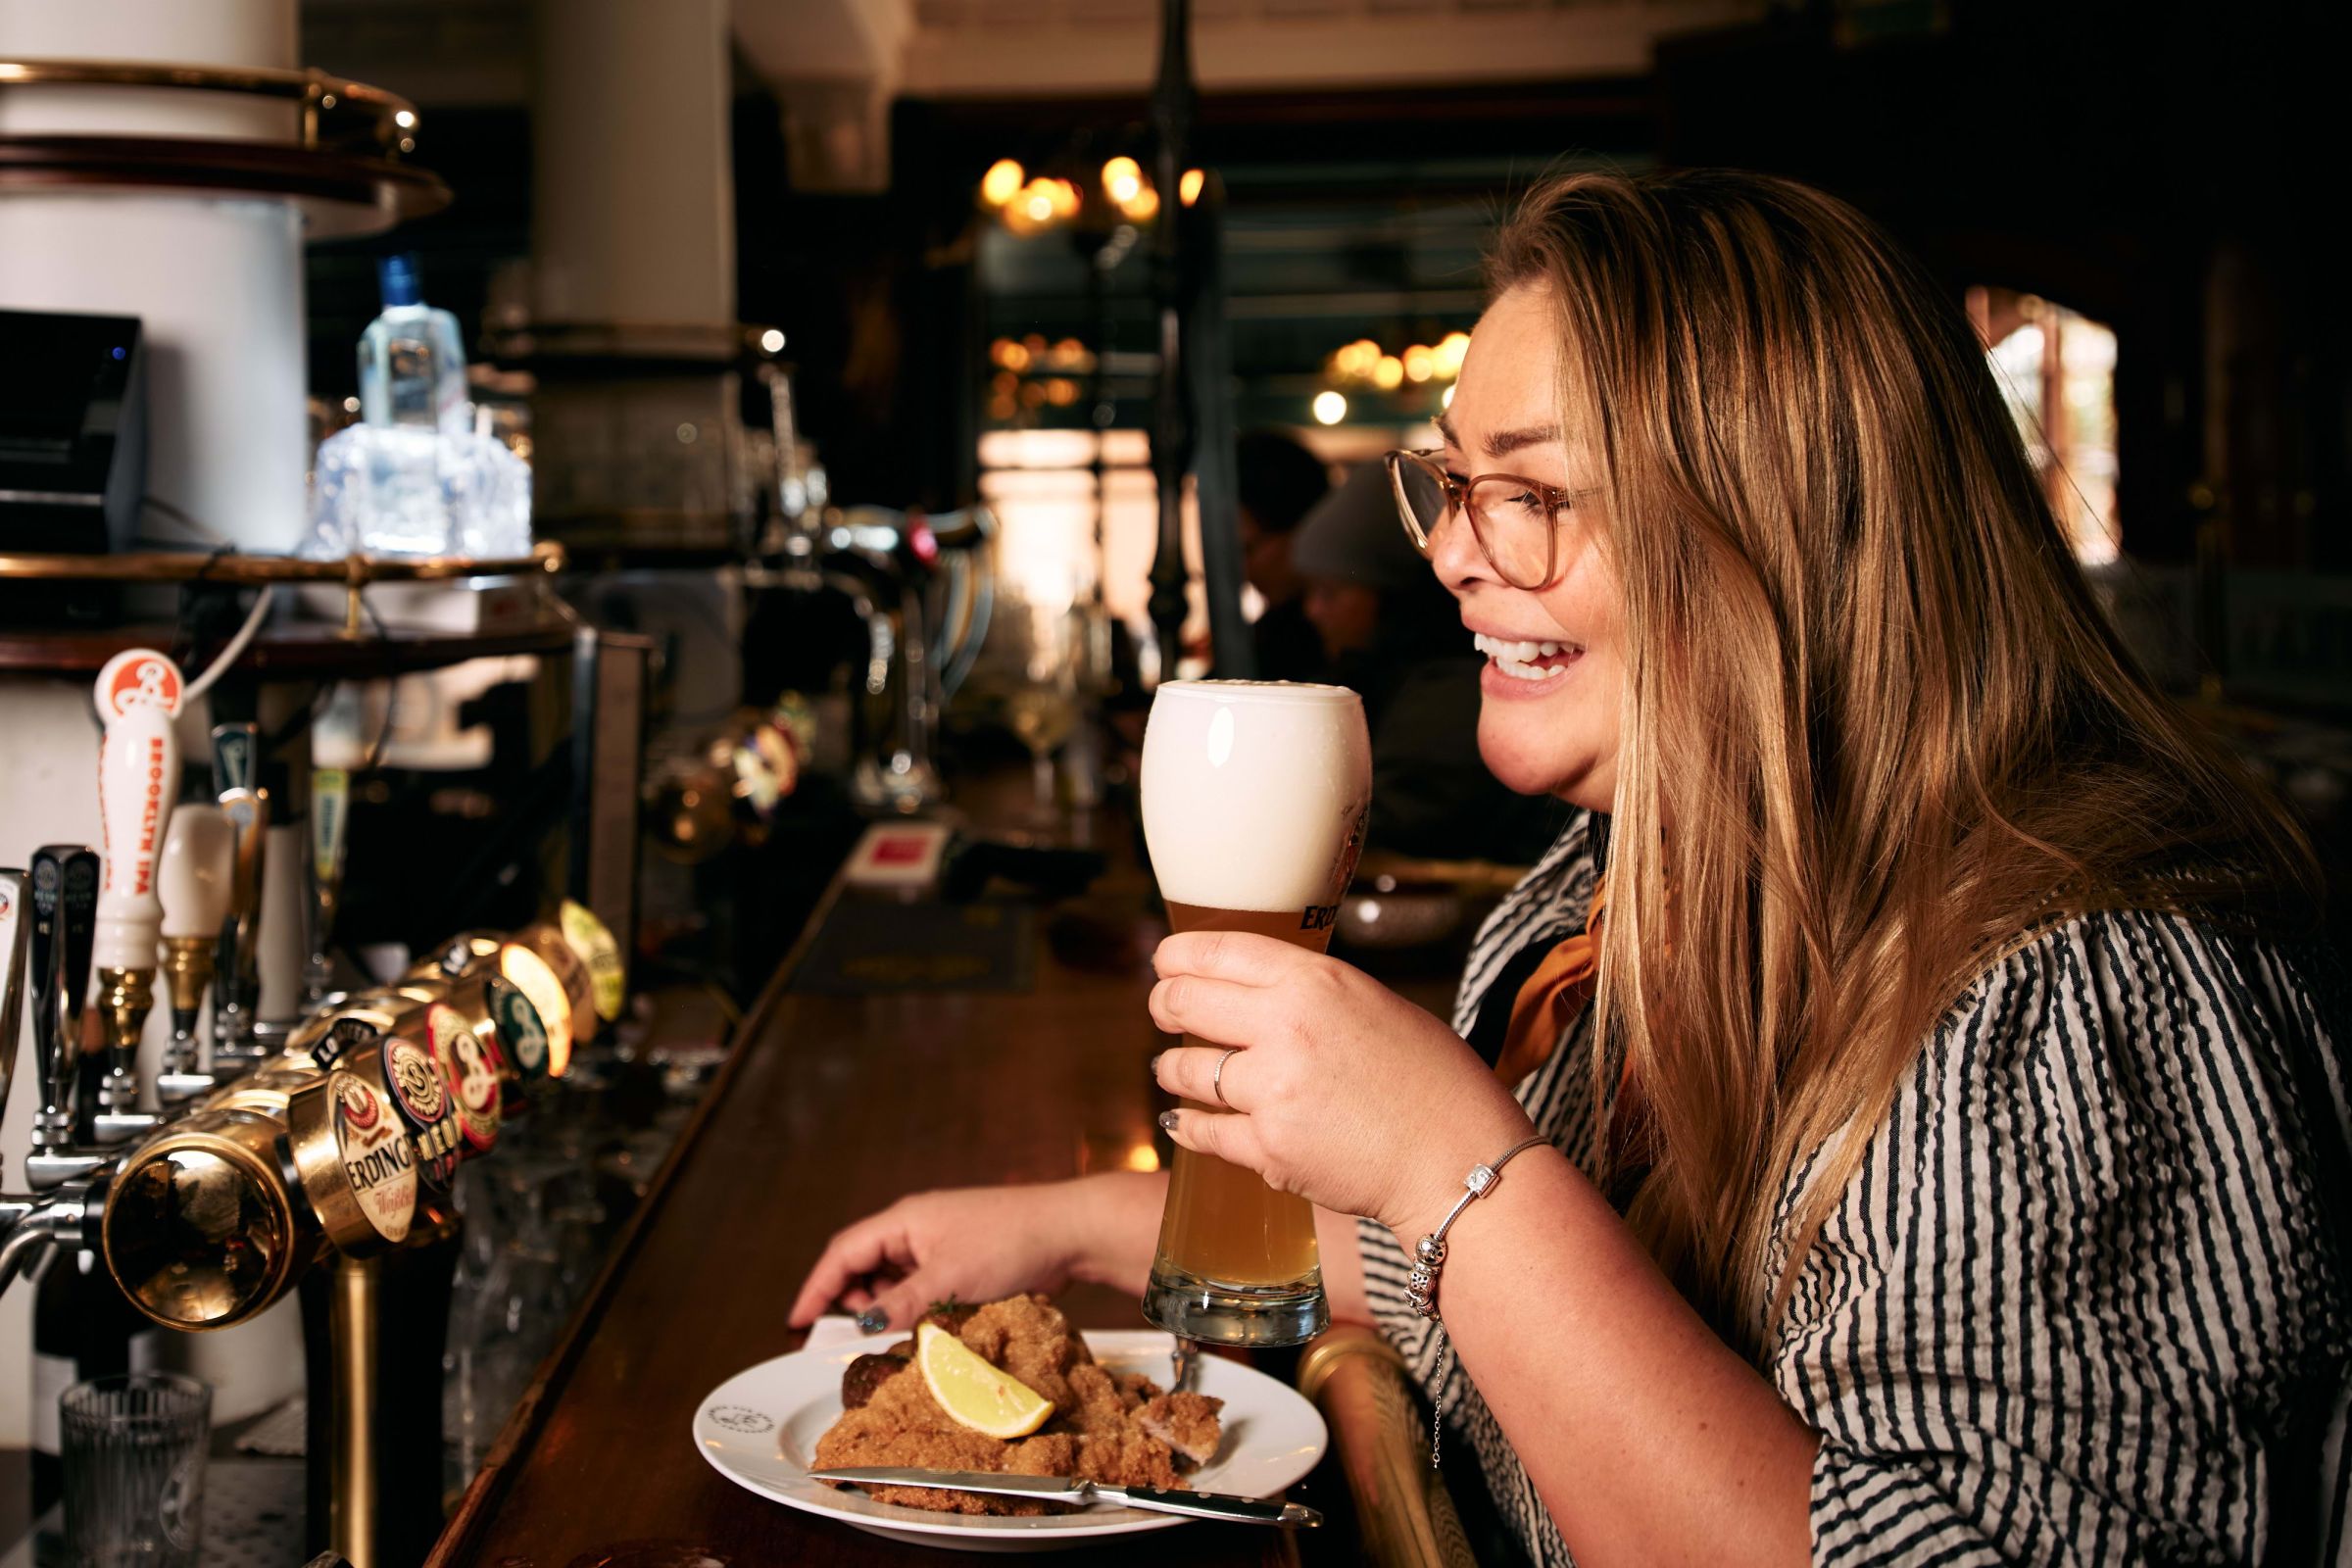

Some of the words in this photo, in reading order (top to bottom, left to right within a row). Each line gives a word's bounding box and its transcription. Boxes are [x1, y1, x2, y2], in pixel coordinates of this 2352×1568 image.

[138, 737, 164, 853] BROOKLYN
[135, 860, 152, 895] IPA
[345, 1133, 415, 1192] ERDING
